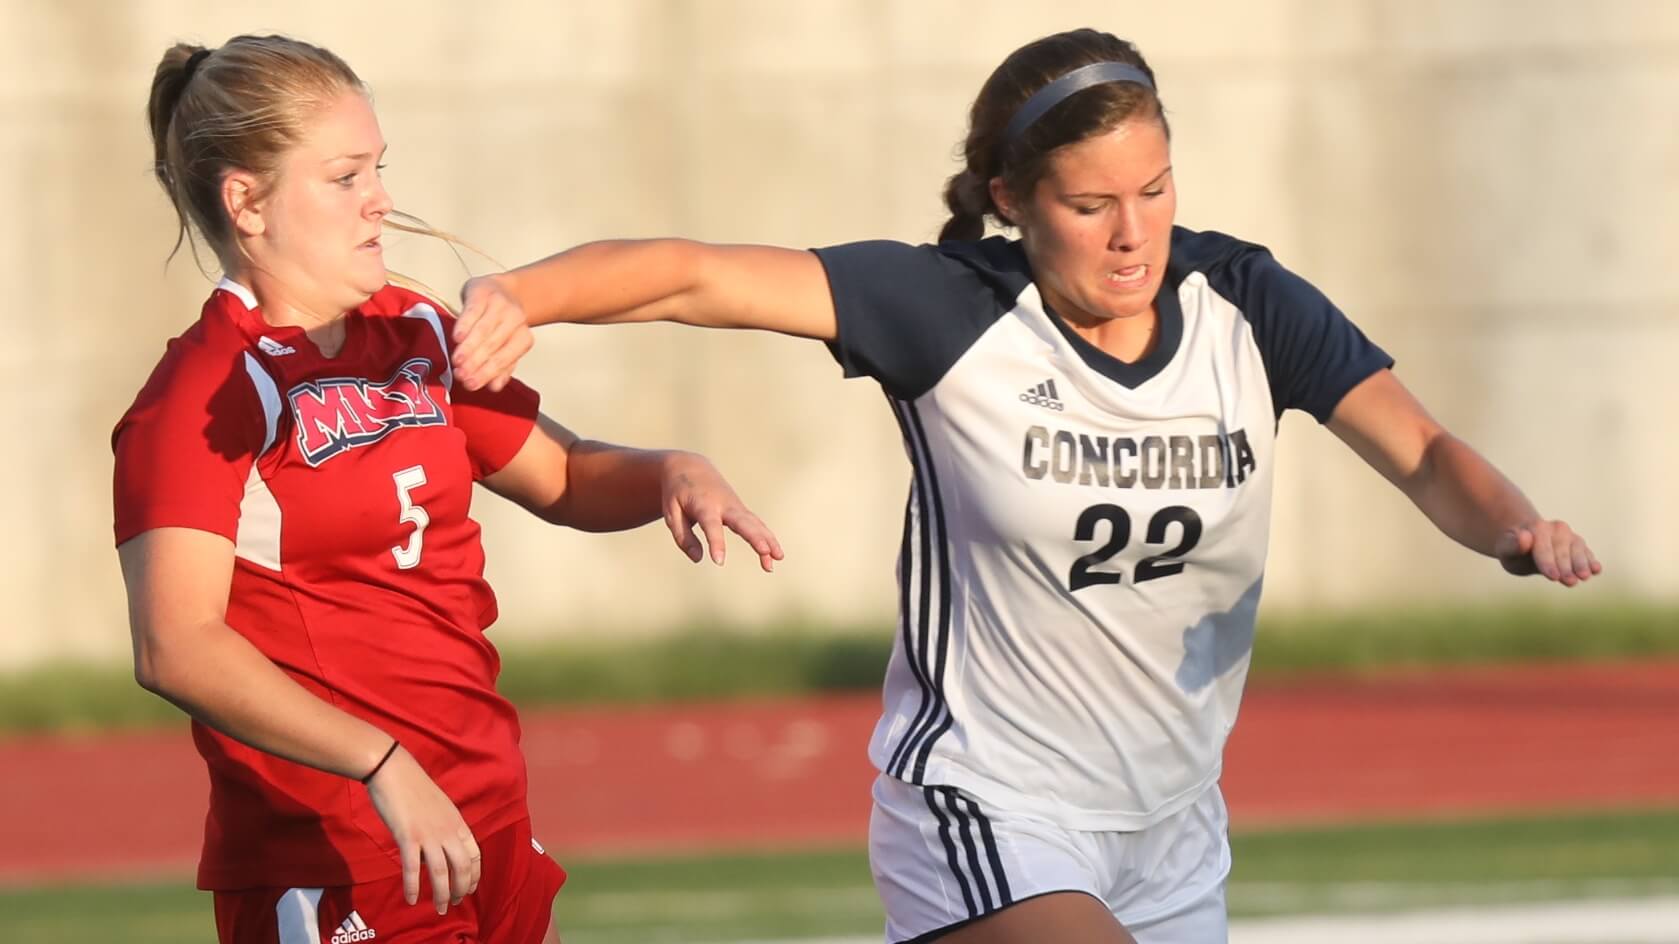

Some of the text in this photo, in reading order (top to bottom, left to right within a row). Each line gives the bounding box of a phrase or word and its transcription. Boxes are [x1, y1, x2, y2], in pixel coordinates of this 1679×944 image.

[391, 464, 431, 570] 5
[1069, 503, 1203, 593] 22
[331, 928, 376, 944] adidas
